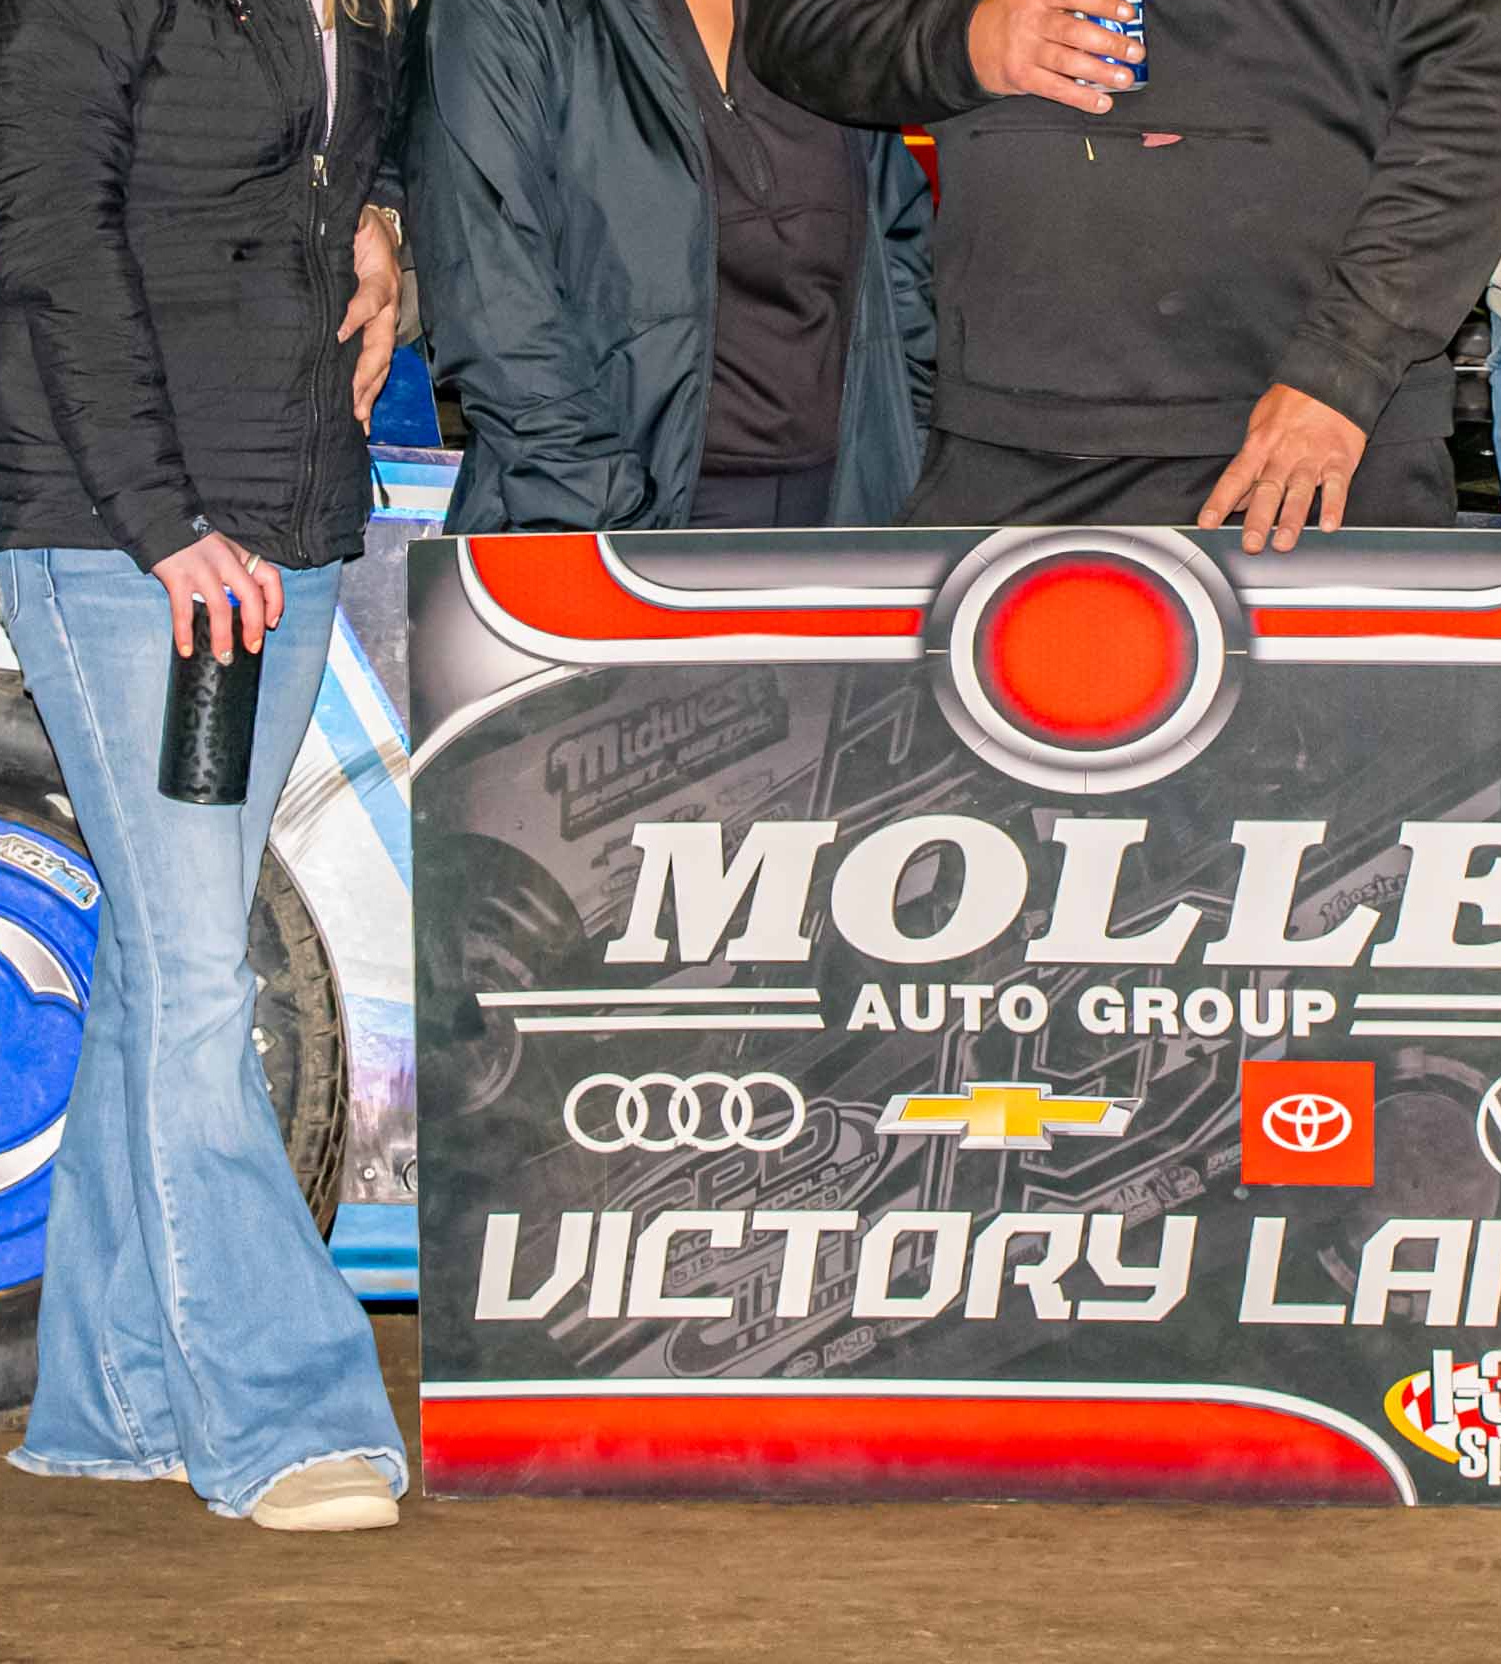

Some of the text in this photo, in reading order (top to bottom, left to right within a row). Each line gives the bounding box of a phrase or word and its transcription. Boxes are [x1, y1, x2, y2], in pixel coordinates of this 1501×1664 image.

[847, 983, 1337, 1038] AUTO GROUP
[474, 1210, 1197, 1324] VICTORY
